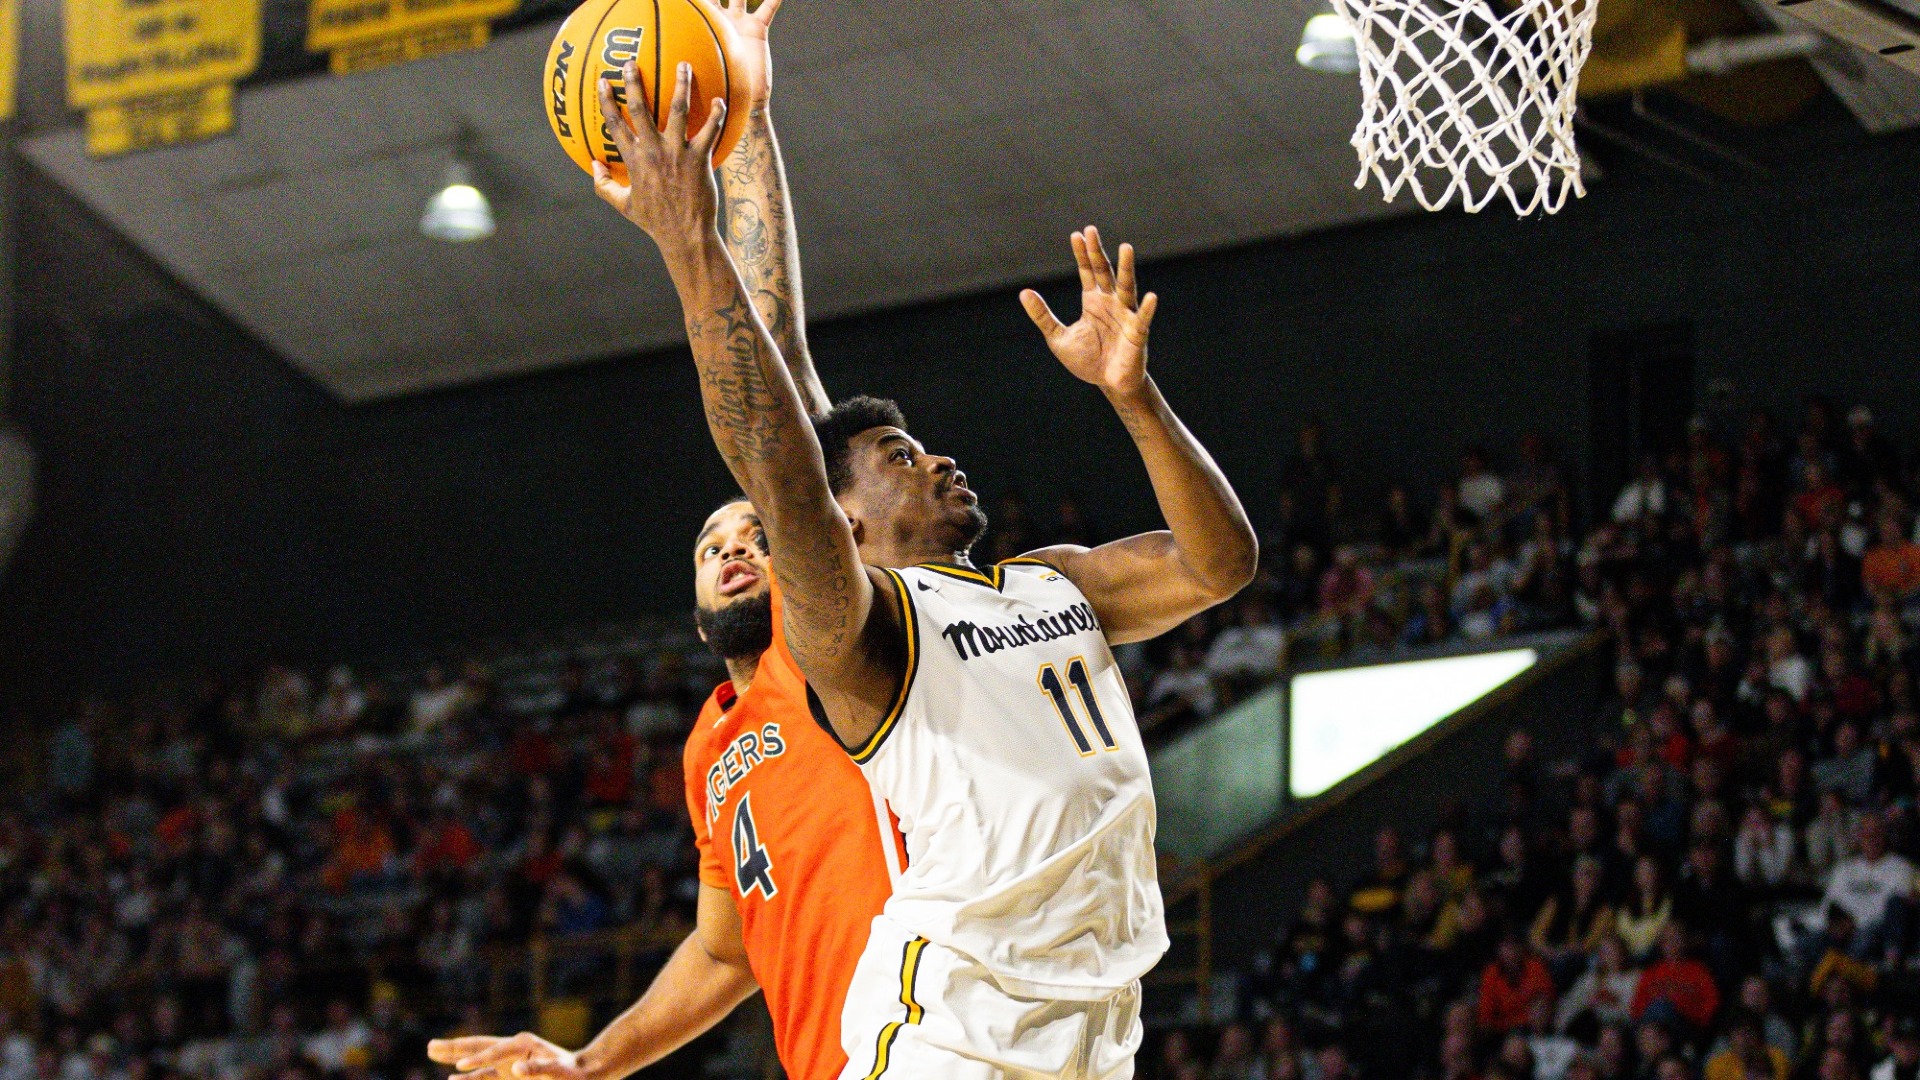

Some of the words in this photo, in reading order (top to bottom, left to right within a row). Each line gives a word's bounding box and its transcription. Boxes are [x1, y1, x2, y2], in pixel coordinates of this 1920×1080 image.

[552, 40, 575, 138] NCAA
[1037, 655, 1119, 757] 11
[706, 722, 786, 838] IGERS
[731, 790, 778, 901] 4
